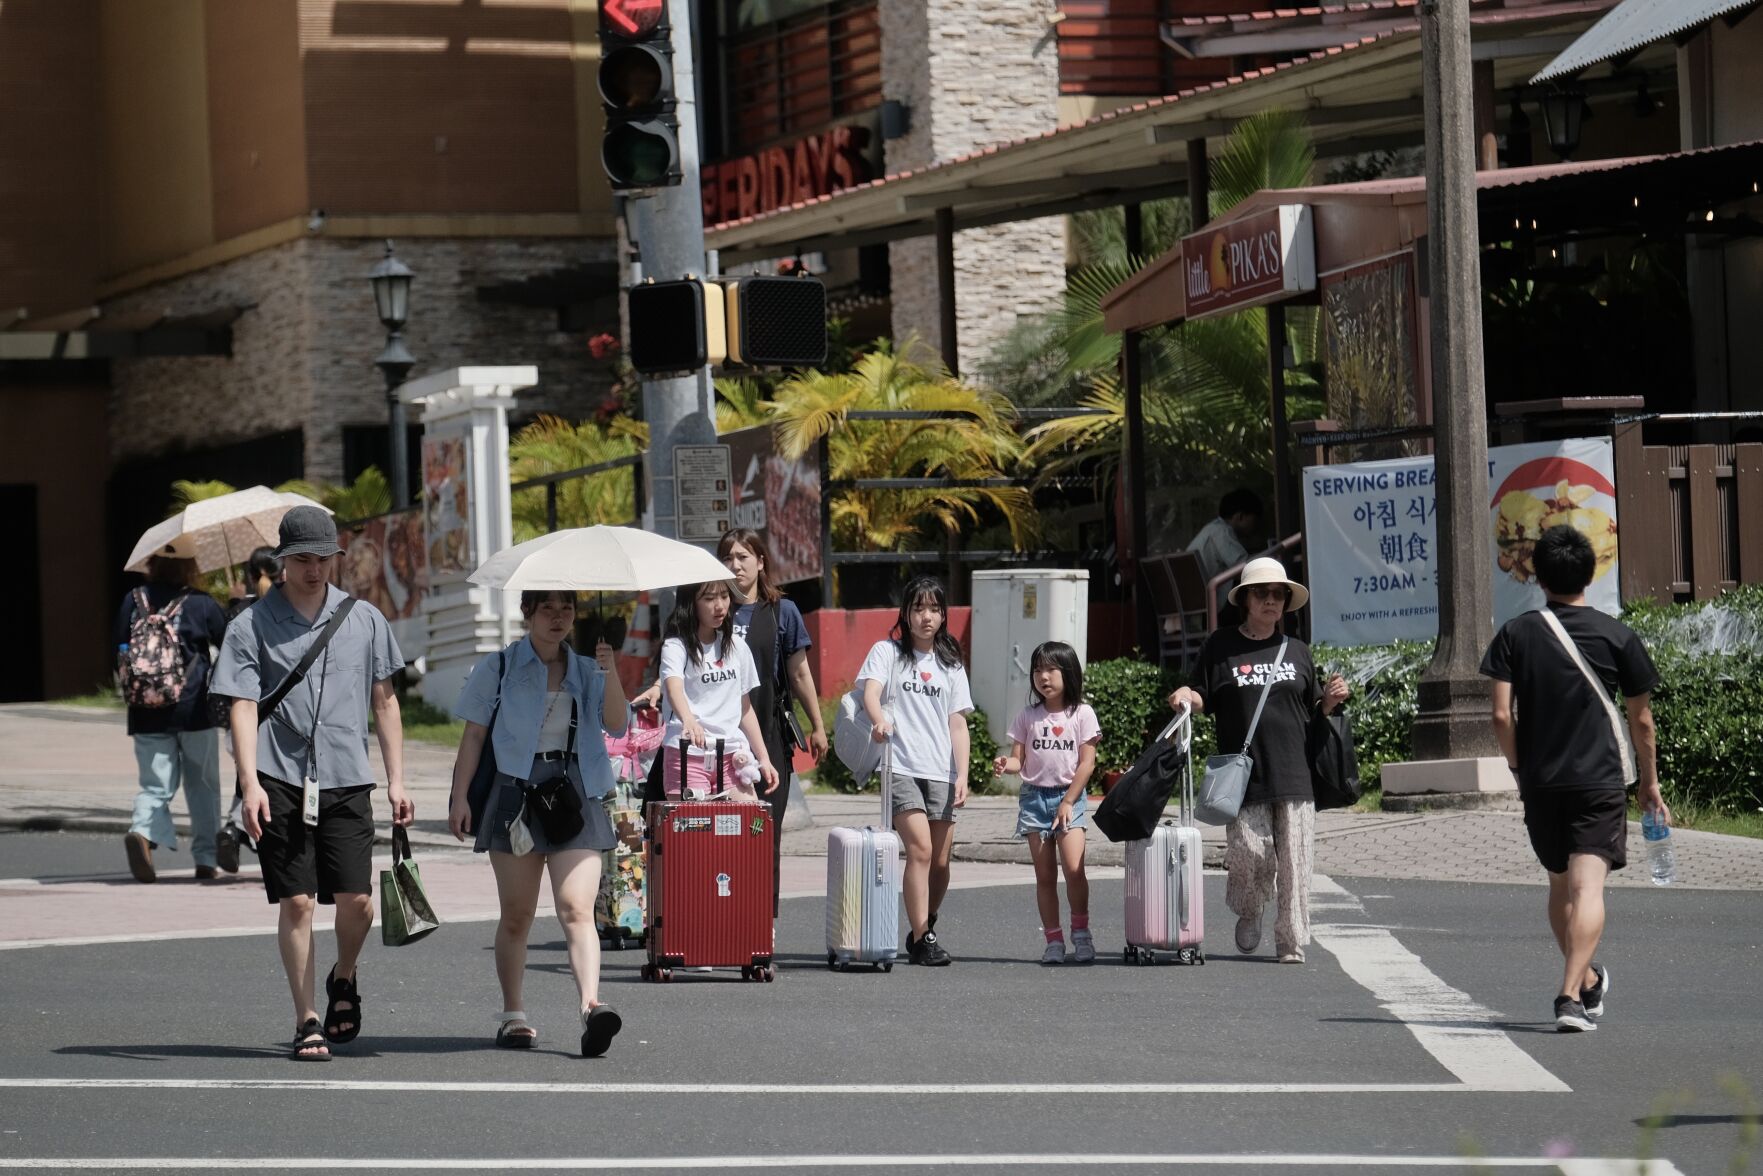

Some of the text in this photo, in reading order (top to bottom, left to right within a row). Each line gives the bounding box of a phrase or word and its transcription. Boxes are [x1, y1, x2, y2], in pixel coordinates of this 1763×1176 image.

[1187, 230, 1279, 298] little PIKA'S
[1313, 473, 1389, 496] SERVING
[1354, 499, 1397, 531] 아침
[1380, 532, 1428, 564] 朝食
[1354, 573, 1416, 593] 7:30AM
[1341, 604, 1438, 622] ENJOY WITH A REFRESHI
[701, 668, 737, 684] GUAM
[912, 670, 917, 680] I
[1232, 666, 1239, 678] I
[902, 681, 941, 698] GUAM
[1042, 726, 1049, 737] I
[1032, 739, 1074, 751] GUAM
